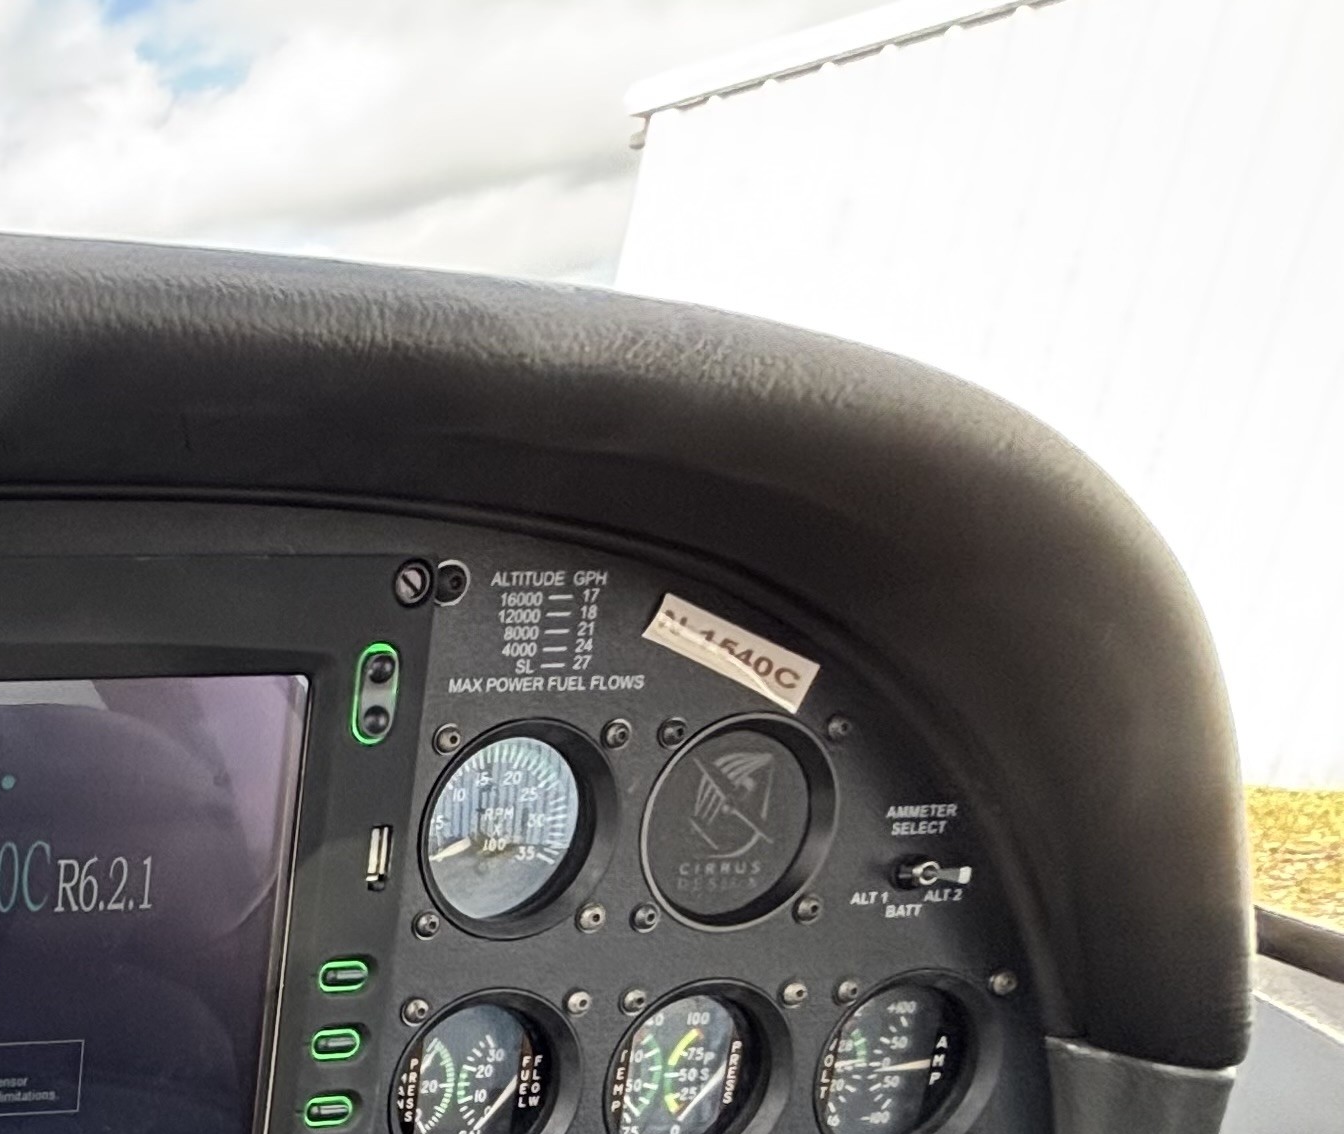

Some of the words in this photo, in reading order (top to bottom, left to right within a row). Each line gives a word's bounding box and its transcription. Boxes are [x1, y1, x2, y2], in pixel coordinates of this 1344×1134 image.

[491, 571, 565, 586] ALTITUDE
[573, 571, 607, 585] GPH
[501, 592, 543, 606] 16000
[583, 589, 600, 602] 17
[499, 609, 540, 623] 12000
[581, 606, 597, 619] 18
[504, 626, 539, 640] 8000
[578, 623, 594, 636] 21
[502, 643, 537, 657] 4000
[576, 640, 593, 653] 24
[516, 660, 534, 674] SL
[573, 656, 591, 670] 27
[449, 678, 482, 693] MAX
[487, 677, 544, 692] POWER
[548, 676, 586, 690] FUEL
[590, 675, 644, 689] FLOWS
[888, 804, 957, 819] AMMETER
[892, 821, 948, 835] SELECT
[53, 855, 152, 914] R6.2.1
[886, 903, 922, 918] BATT
